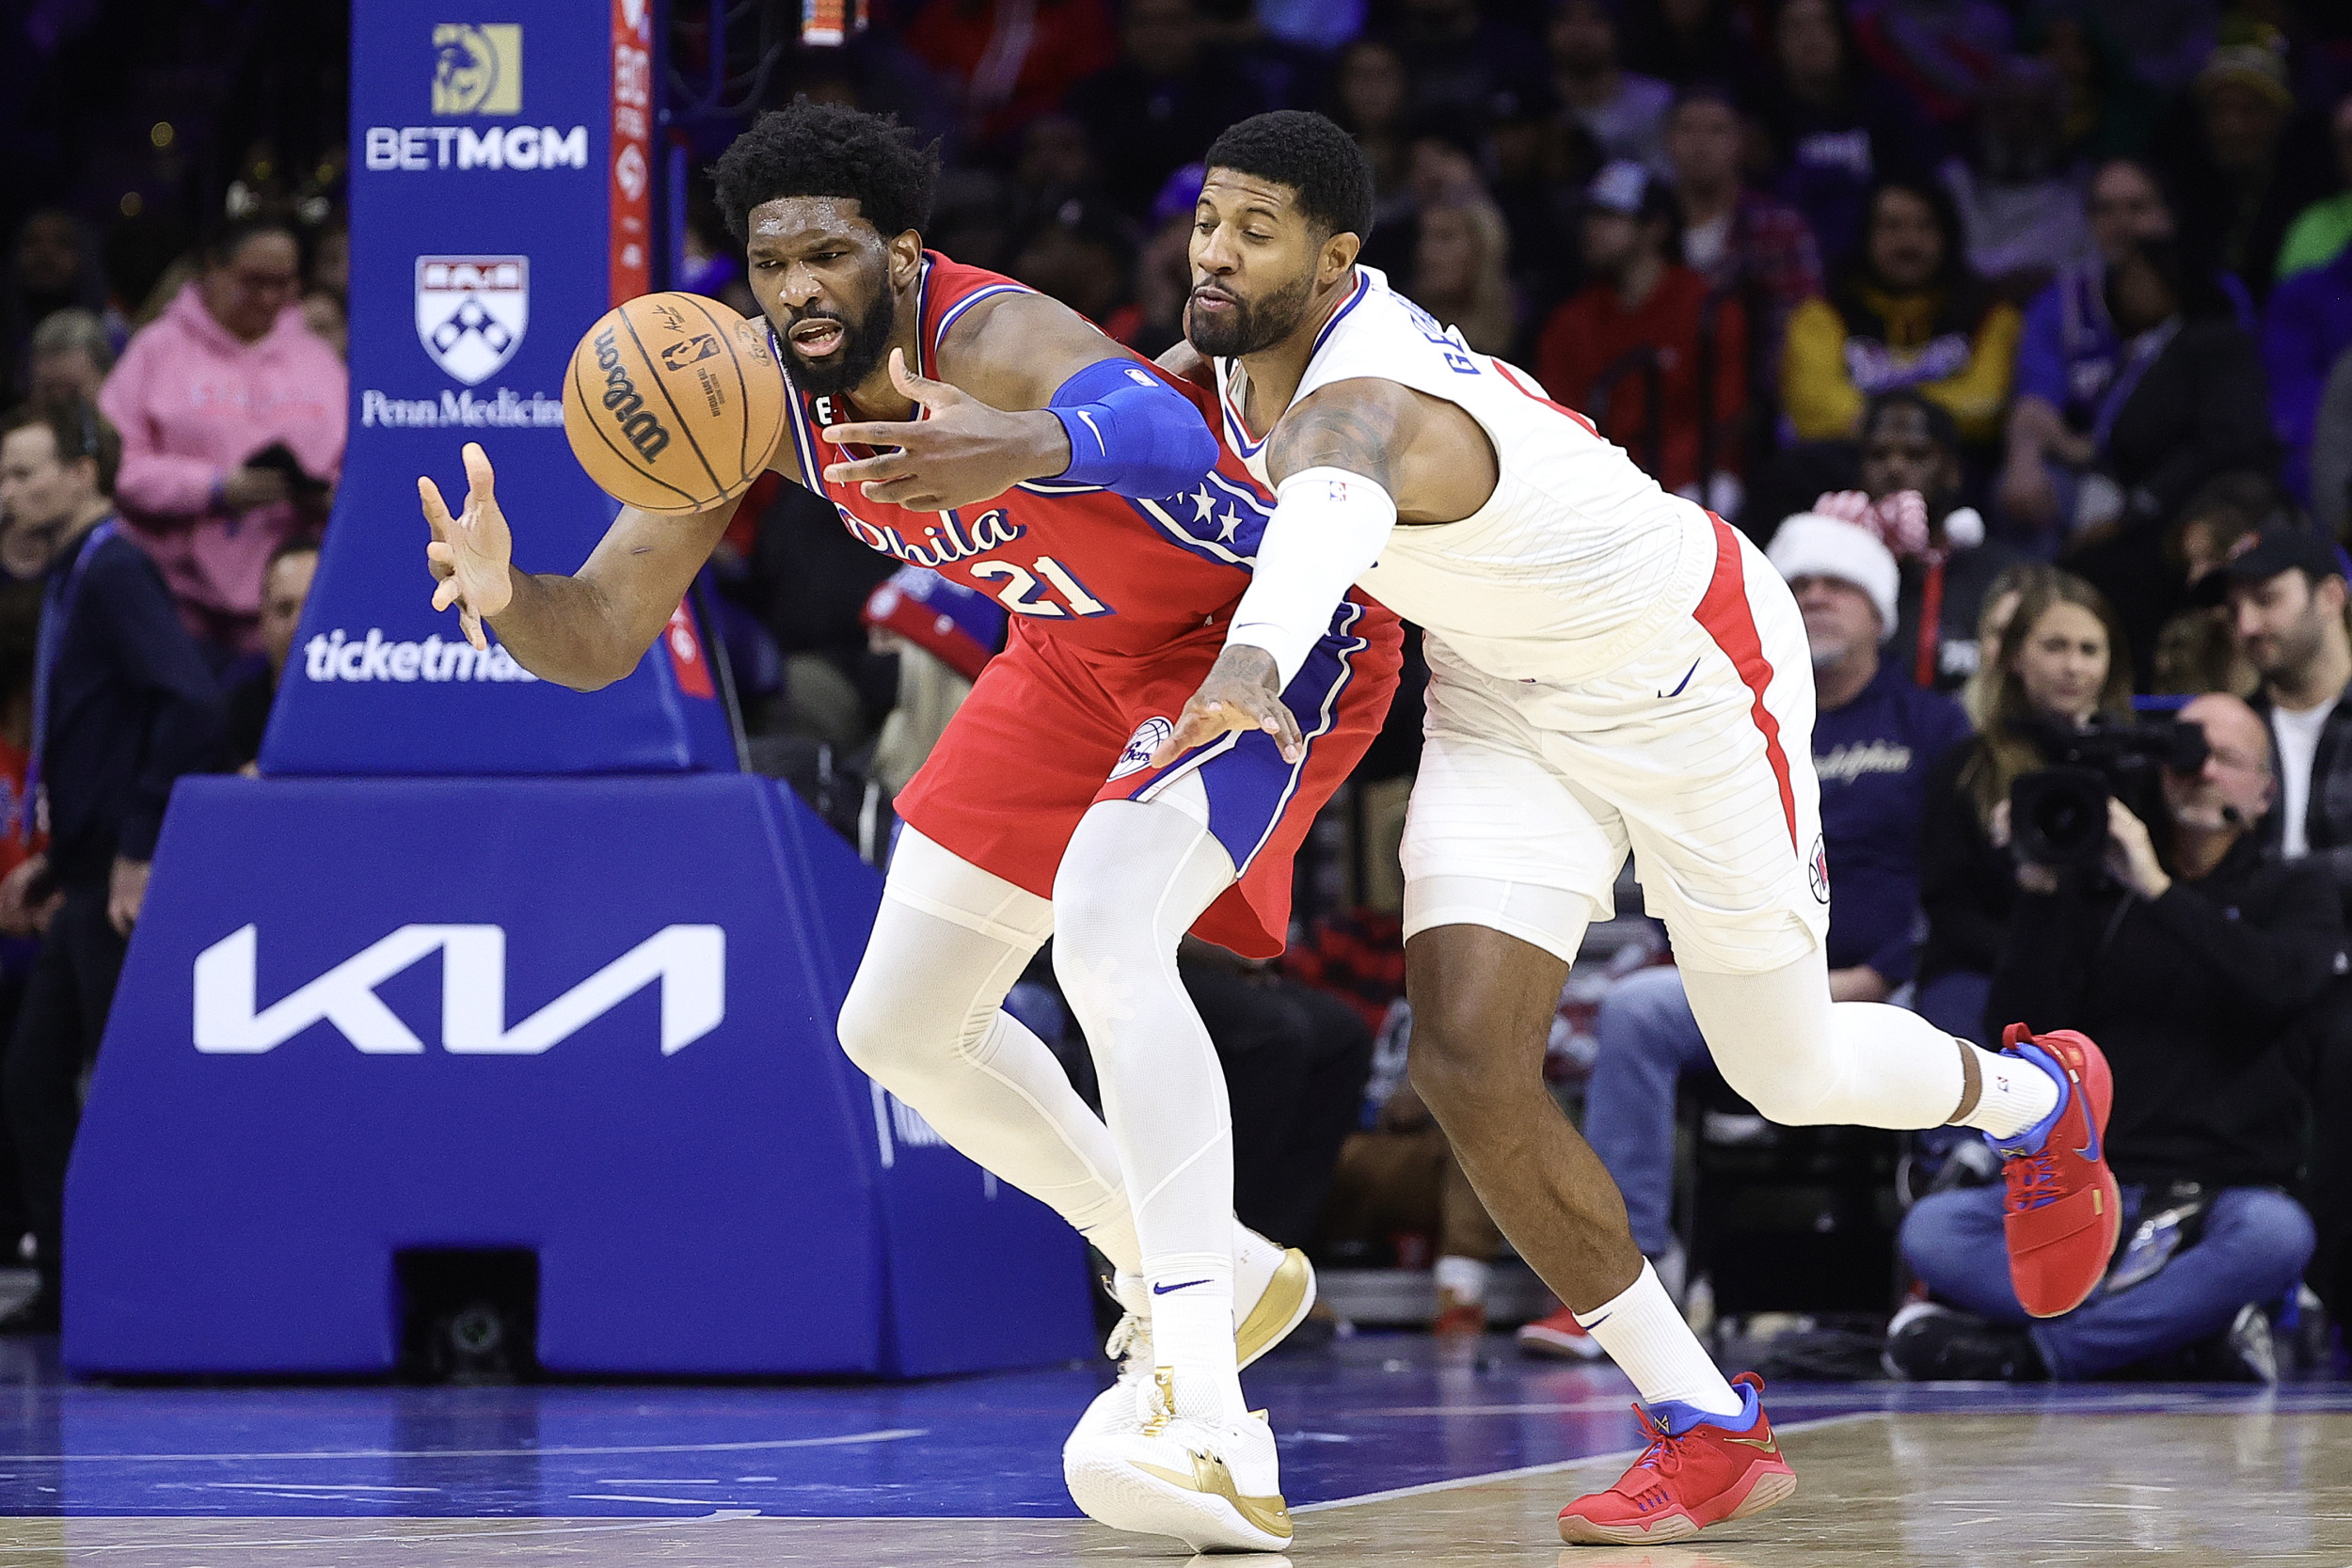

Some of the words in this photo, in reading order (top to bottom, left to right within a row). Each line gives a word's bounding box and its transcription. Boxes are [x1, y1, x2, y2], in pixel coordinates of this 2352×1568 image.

[365, 125, 589, 171] BETMGM
[361, 388, 438, 428] Penn
[439, 387, 564, 427] Medicin
[592, 324, 671, 466] Wilson
[969, 556, 1112, 620] 21
[303, 627, 540, 683] ticketma
[193, 923, 725, 1056] KIA
